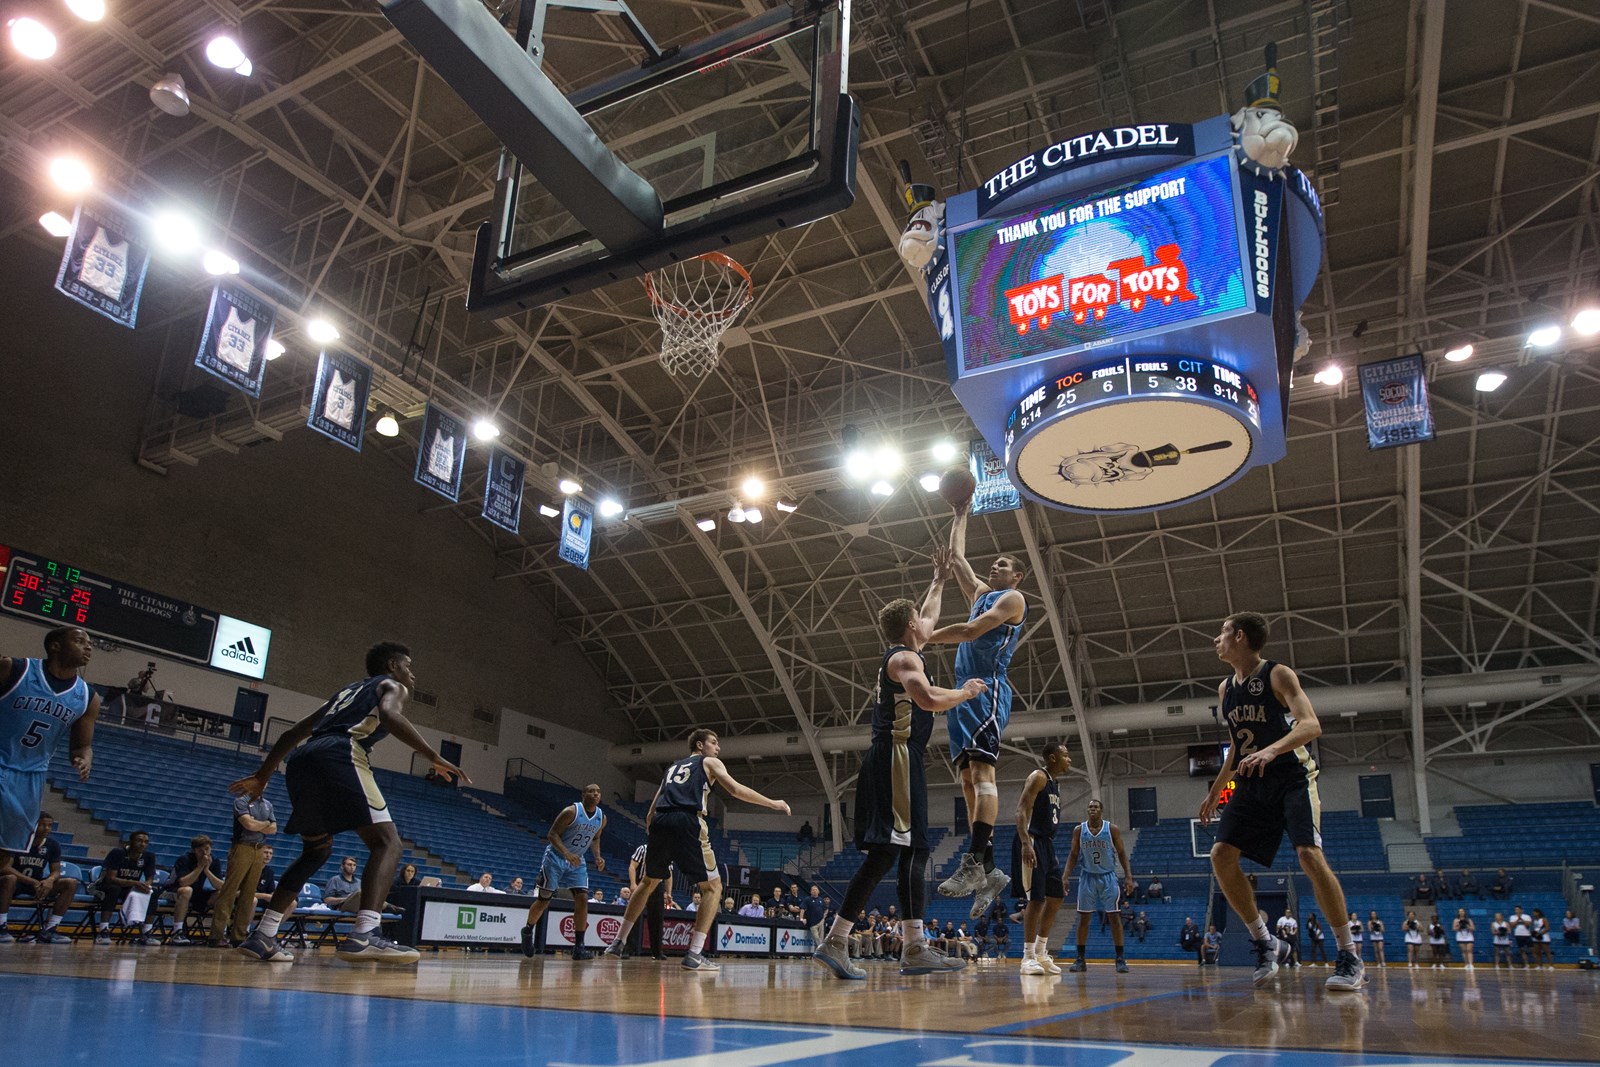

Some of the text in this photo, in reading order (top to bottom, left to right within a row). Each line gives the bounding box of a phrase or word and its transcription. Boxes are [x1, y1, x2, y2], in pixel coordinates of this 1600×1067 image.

[985, 124, 1179, 200] THE CITADEL
[997, 177, 1186, 244] THANK YOU FOR THE SUPPORT
[1254, 189, 1269, 298] BULLDOGS
[95, 256, 116, 278] 33
[931, 264, 950, 294] CLASS OF
[1011, 267, 1180, 317] TOYS FOR TOTS
[229, 334, 246, 352] 33
[1135, 362, 1168, 372] FOULS
[1178, 360, 1203, 374] CIT
[1212, 364, 1242, 389] TIME
[1365, 360, 1418, 378] CITADEL
[1020, 385, 1046, 414] TIME
[1056, 372, 1083, 390] TOC
[1092, 365, 1124, 379] FOULS
[1148, 376, 1159, 388] 5
[1175, 376, 1197, 392] 38
[1213, 384, 1238, 403] 9:14
[1379, 383, 1410, 401] SOCON
[1021, 407, 1041, 429] 9:14
[1056, 389, 1077, 409] 25
[1102, 380, 1113, 392] 6
[1372, 404, 1425, 420] CONFERENCE
[500, 455, 516, 481] C
[17, 572, 40, 591] 38
[70, 588, 91, 606] 25
[117, 587, 181, 613] THE CITADEL
[12, 590, 25, 605] 5
[76, 608, 88, 622] 6
[121, 598, 172, 619] BULLDOGS
[221, 648, 259, 665] adidas
[1250, 681, 1262, 693] 33
[145, 703, 161, 728] C
[20, 719, 51, 748] 5
[1237, 728, 1258, 755] 2
[666, 762, 693, 785] 15
[1052, 808, 1059, 825] 3
[571, 833, 591, 848] 23
[1092, 851, 1100, 865] 2
[740, 867, 750, 885] C
[303, 883, 311, 895] C
[479, 912, 506, 923] Bank
[601, 920, 619, 933] Sub
[735, 933, 766, 945] Domino's
